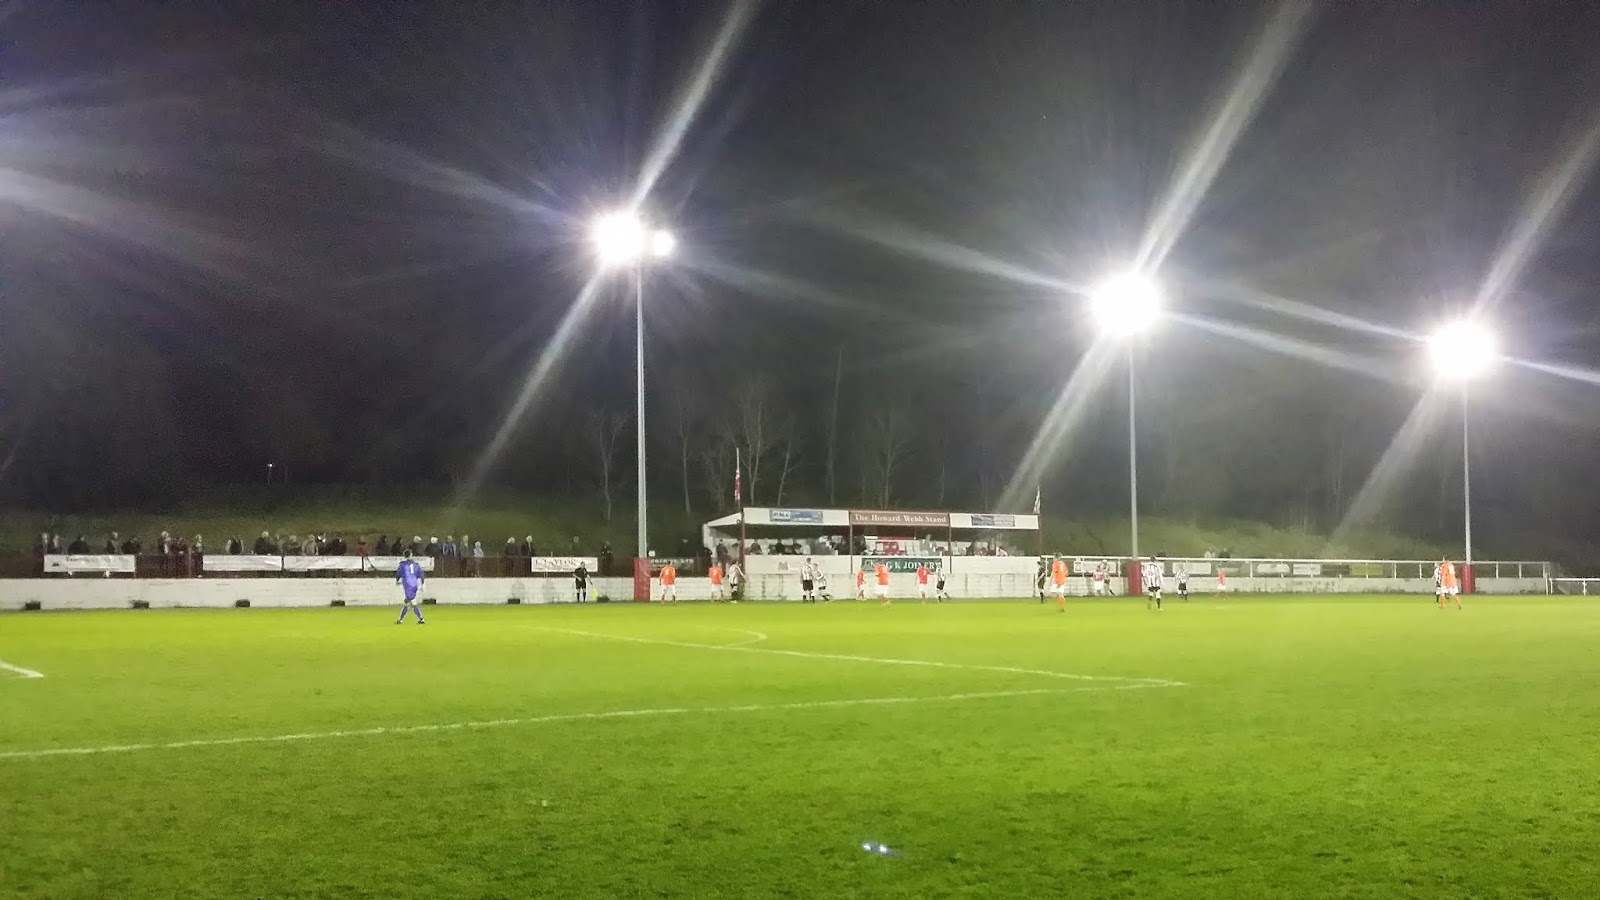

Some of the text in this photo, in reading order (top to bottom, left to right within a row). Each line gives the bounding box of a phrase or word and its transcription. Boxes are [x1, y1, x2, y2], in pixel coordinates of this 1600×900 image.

[855, 513, 946, 523] The Howard Webb Stand
[409, 563, 415, 574] 1
